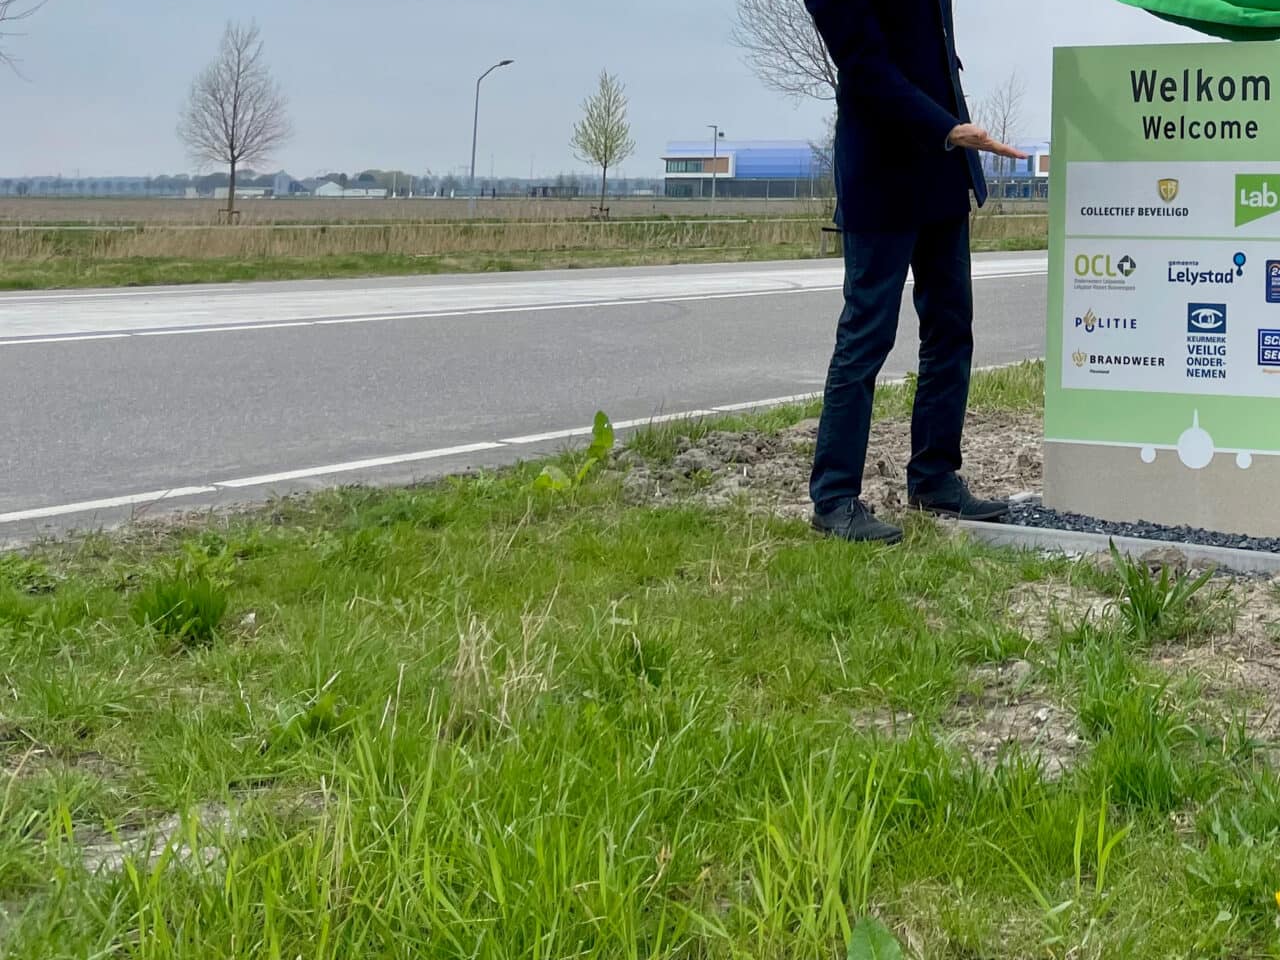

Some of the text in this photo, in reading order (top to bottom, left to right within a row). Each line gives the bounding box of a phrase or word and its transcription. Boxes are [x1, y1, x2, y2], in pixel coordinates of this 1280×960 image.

[1130, 68, 1271, 103] Welkom
[1142, 115, 1259, 140] Welcome
[1240, 182, 1278, 208] Lab
[1080, 206, 1189, 217] COLLECTIEF BEVEILIGD
[1074, 254, 1116, 277] OCL
[1168, 267, 1234, 286] Lelystad
[1187, 344, 1227, 356] VEILIG
[1089, 355, 1165, 368] BRANDWEER
[1186, 356, 1227, 368] ONDER-
[1186, 368, 1227, 379] NEMEN
